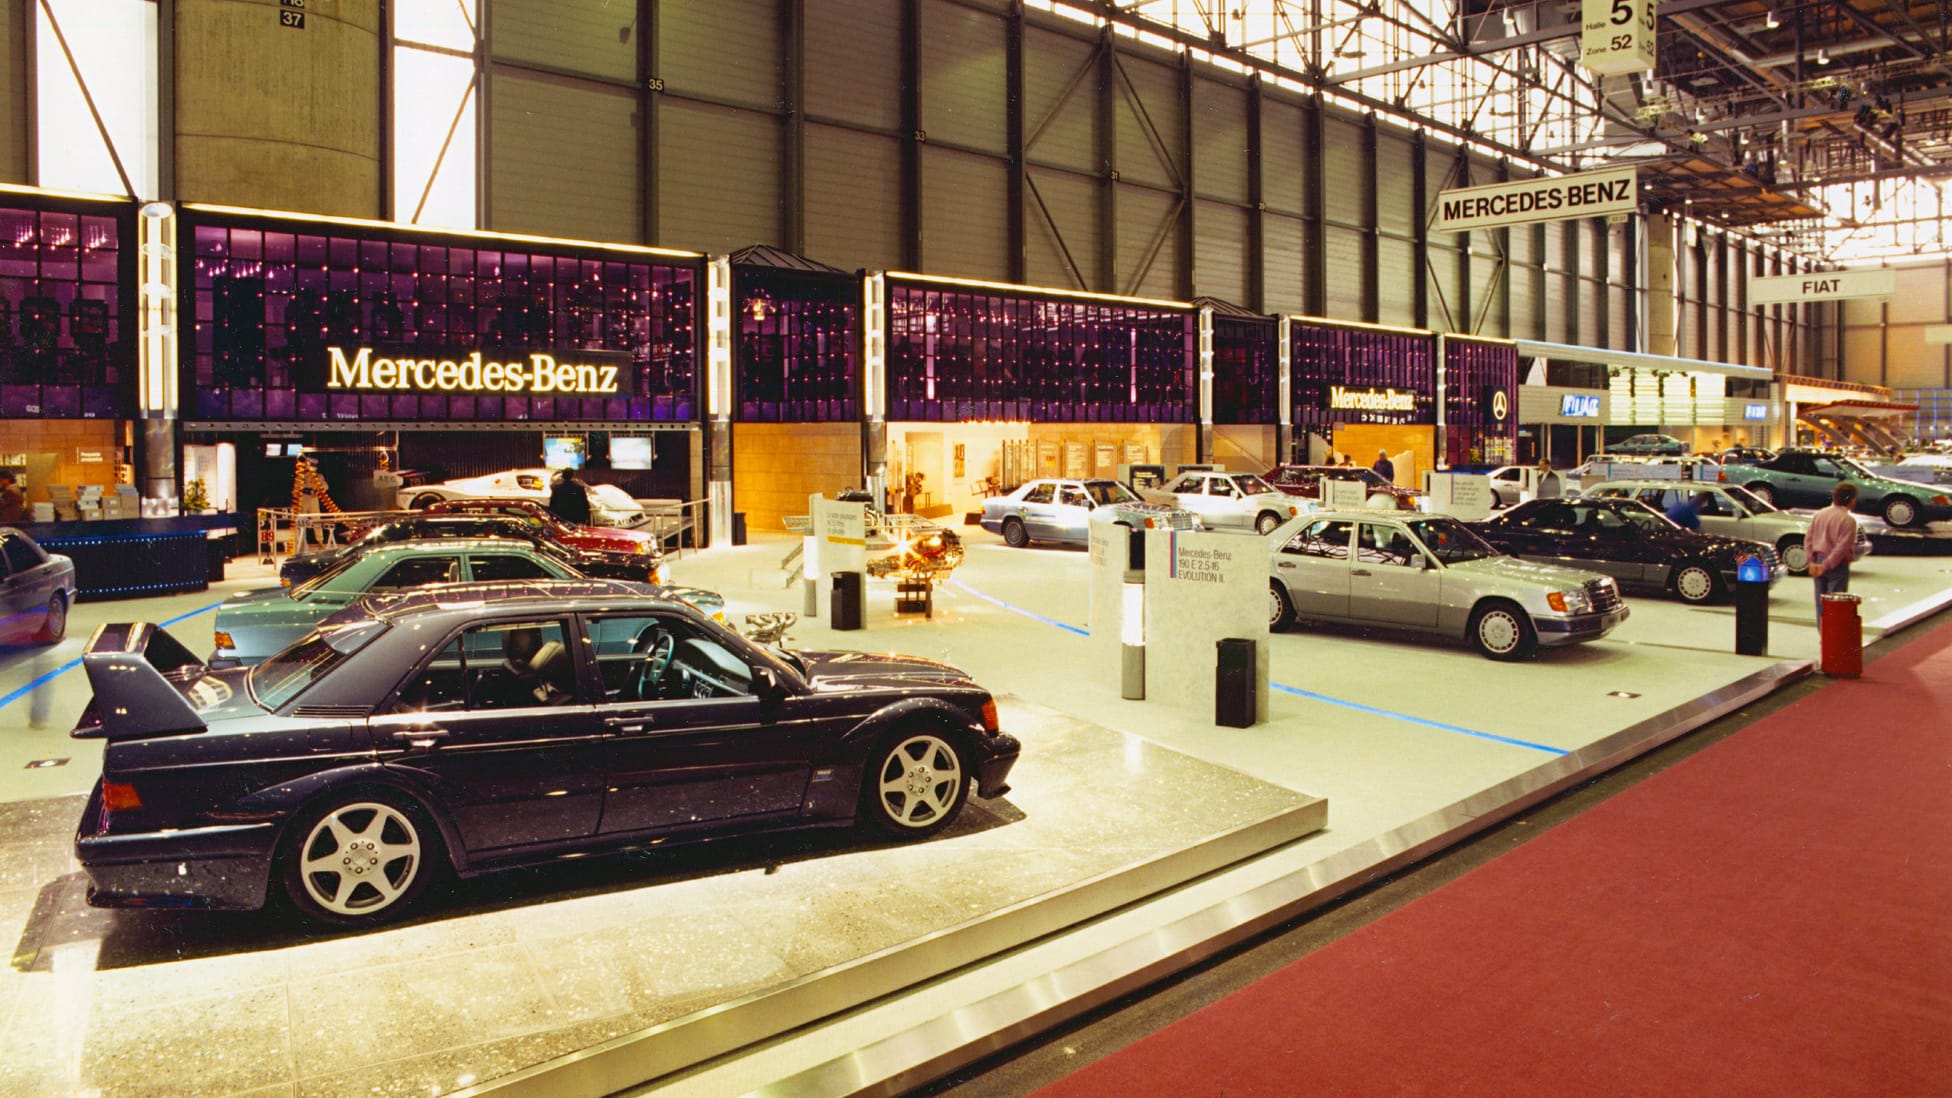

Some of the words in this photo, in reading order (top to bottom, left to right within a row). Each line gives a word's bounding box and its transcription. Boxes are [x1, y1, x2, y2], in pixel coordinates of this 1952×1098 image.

[283, 11, 302, 26] 37
[1610, 0, 1633, 26] 5
[1646, 2, 1655, 31] 5
[1586, 47, 1607, 55] Zone
[1611, 34, 1632, 51] 52
[649, 78, 663, 91] 35
[1443, 179, 1631, 221] MERCEDES-BENZ
[1802, 279, 1841, 294] FIAT
[327, 346, 618, 393] Mercedes-Benz
[1330, 386, 1414, 411] Mercedes-Benz
[1178, 547, 1232, 561] Mercedes-Benz
[1191, 560, 1196, 570] E
[1178, 570, 1217, 583] EVOLUTION
